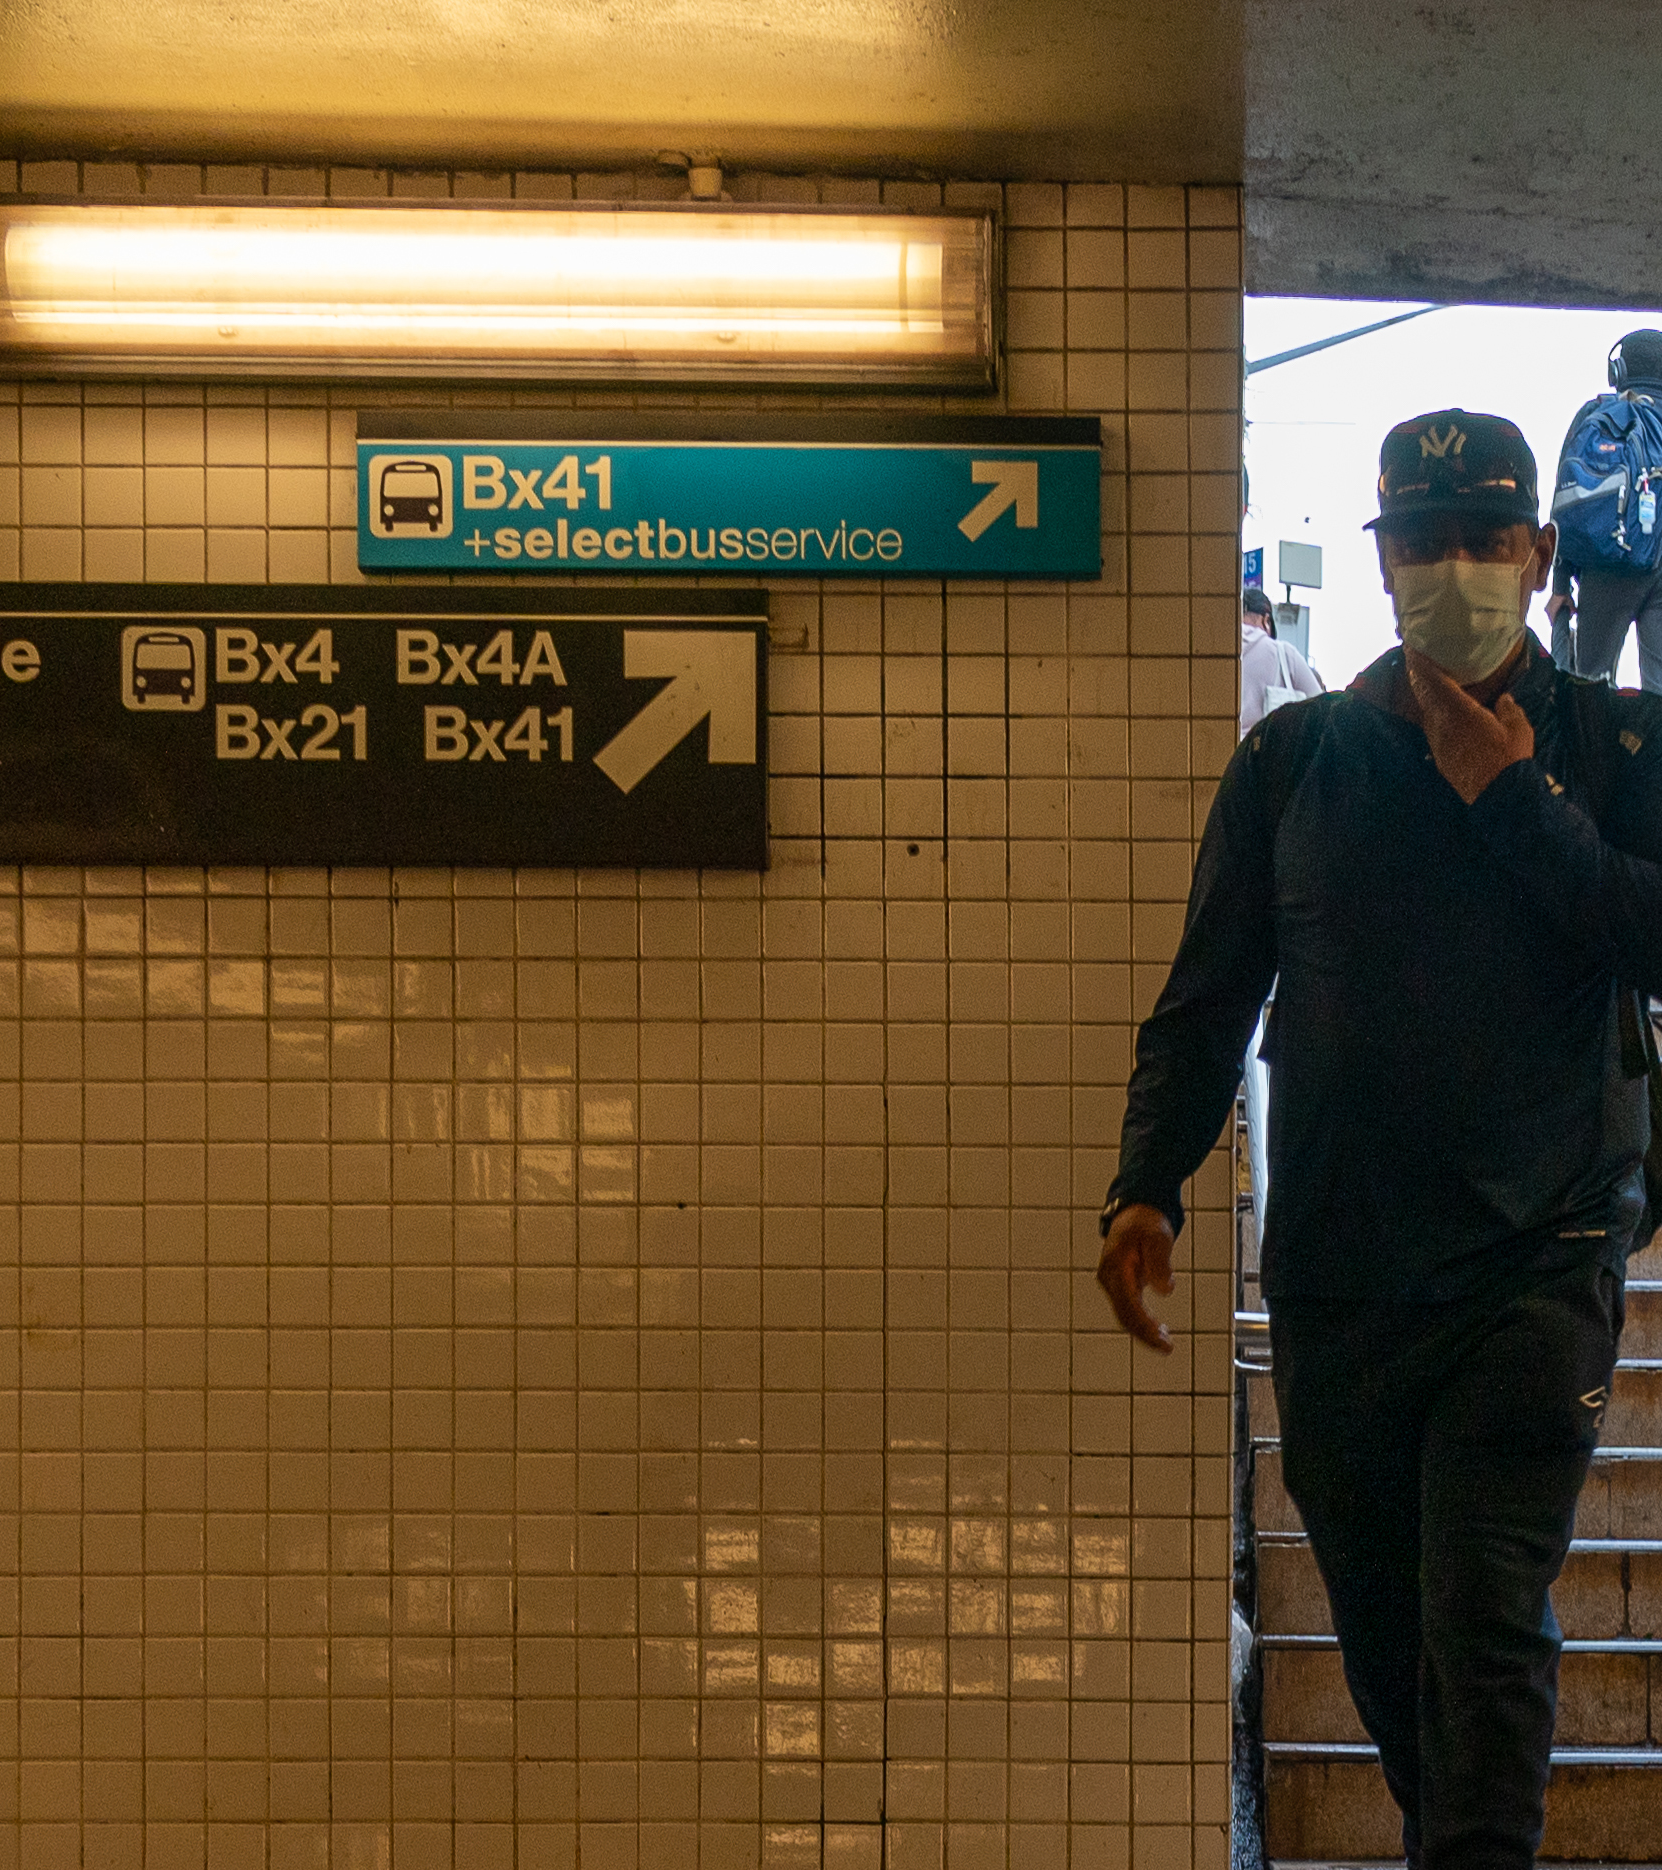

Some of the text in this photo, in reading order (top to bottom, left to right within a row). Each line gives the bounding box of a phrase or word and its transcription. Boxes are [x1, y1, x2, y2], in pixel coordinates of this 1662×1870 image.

[463, 455, 612, 510] Bx41
[215, 628, 568, 686] Bx4 Bx4A
[215, 704, 574, 762] Bx21 Bx41
